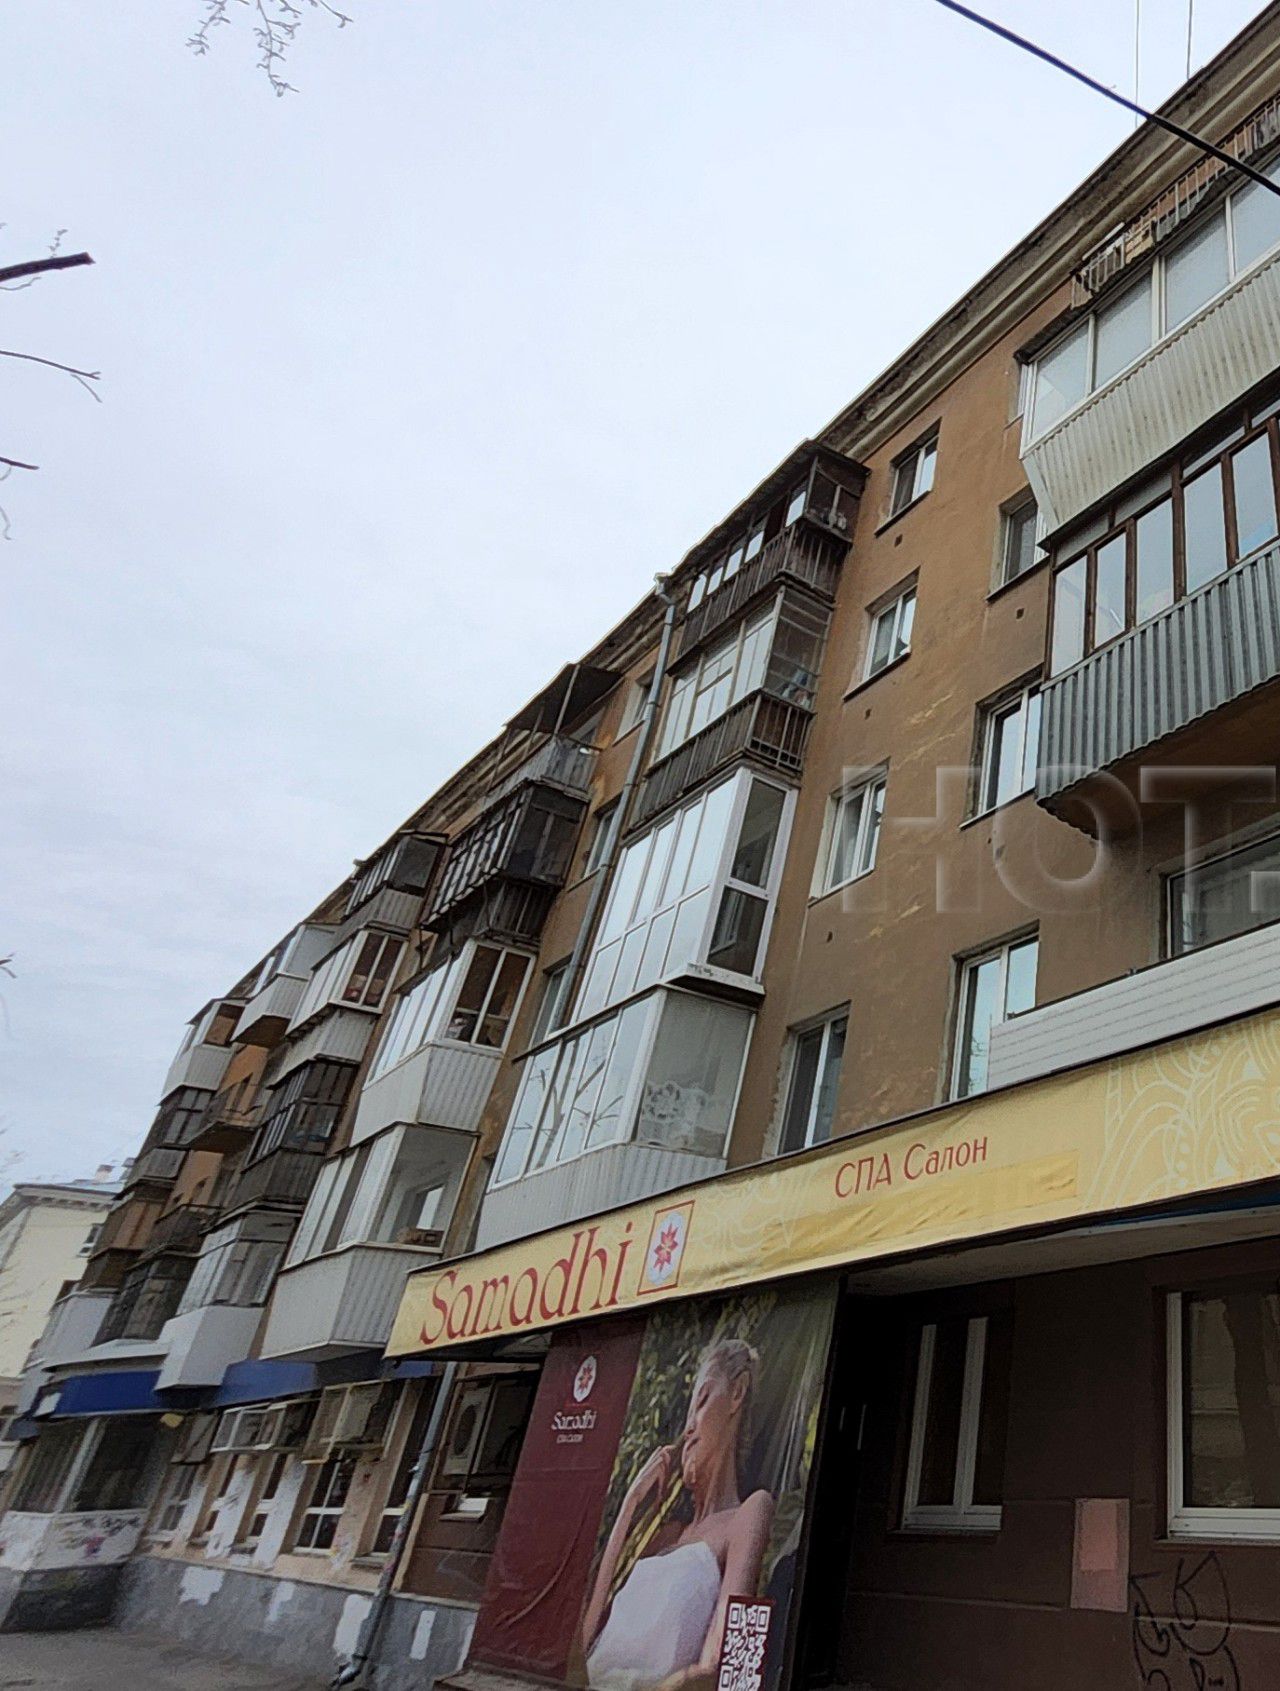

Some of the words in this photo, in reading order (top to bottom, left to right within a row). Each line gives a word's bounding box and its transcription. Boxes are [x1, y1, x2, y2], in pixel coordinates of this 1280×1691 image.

[835, 1153, 892, 1198] СПА
[904, 1136, 988, 1180] Салон
[419, 1221, 633, 1345] Samadhi
